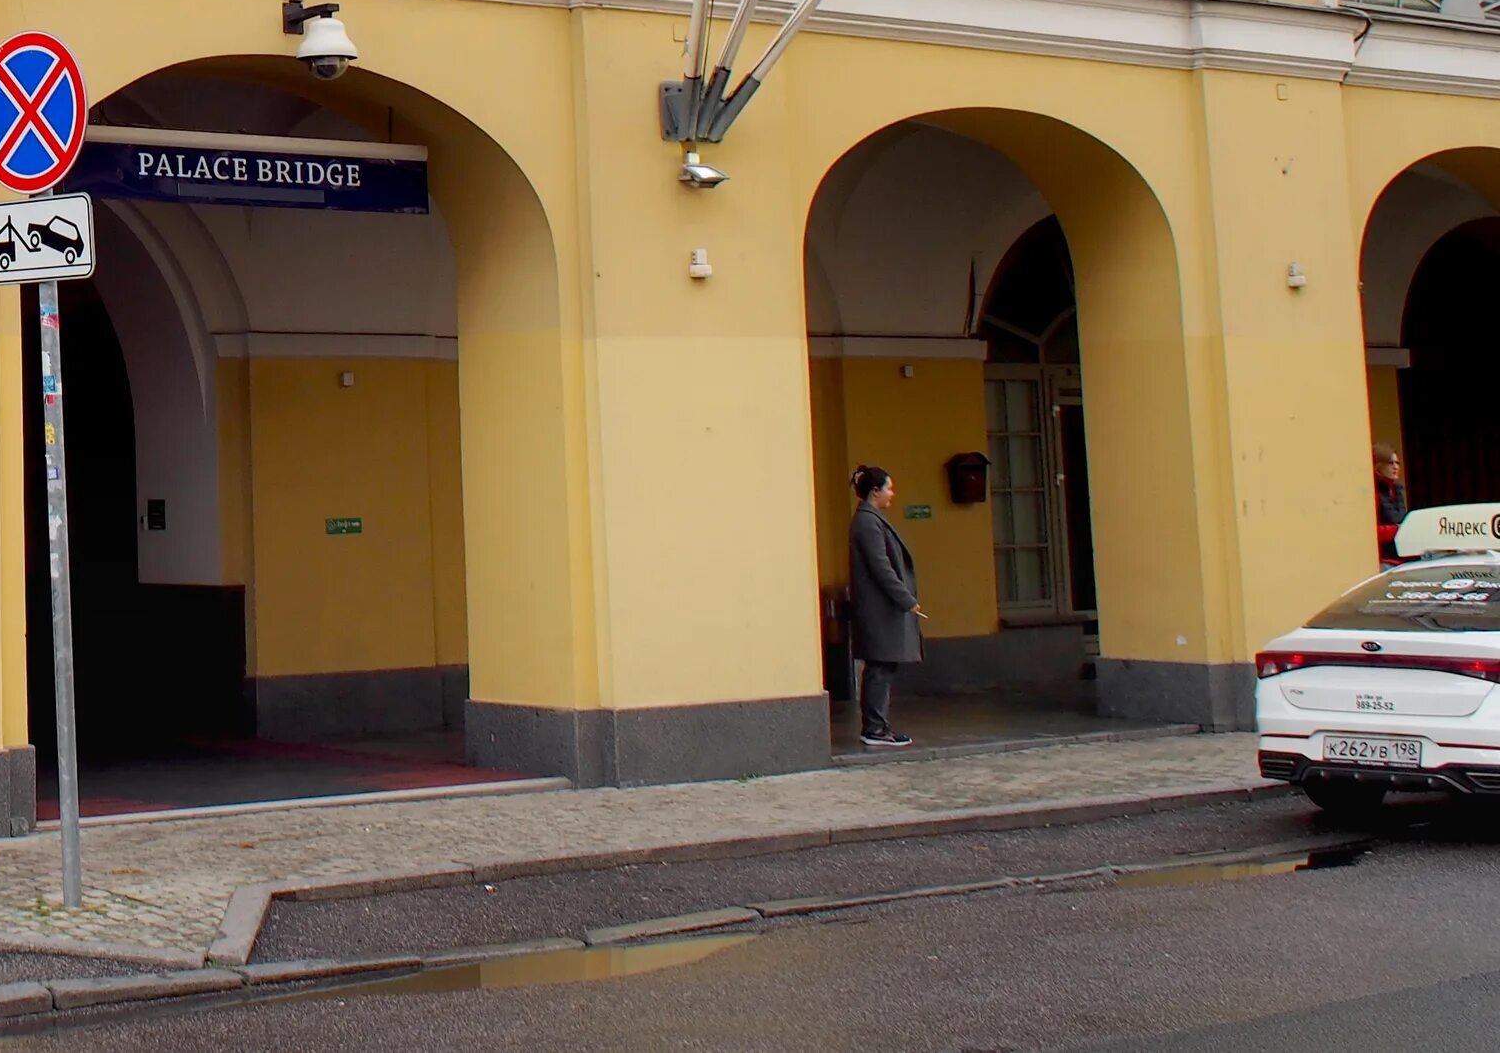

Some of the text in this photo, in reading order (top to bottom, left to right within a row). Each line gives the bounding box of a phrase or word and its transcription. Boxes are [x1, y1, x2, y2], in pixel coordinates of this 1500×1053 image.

[138, 152, 361, 187] PALACE BRIDGE
[1438, 516, 1488, 537] Яндекс
[1393, 742, 1417, 755] 198
